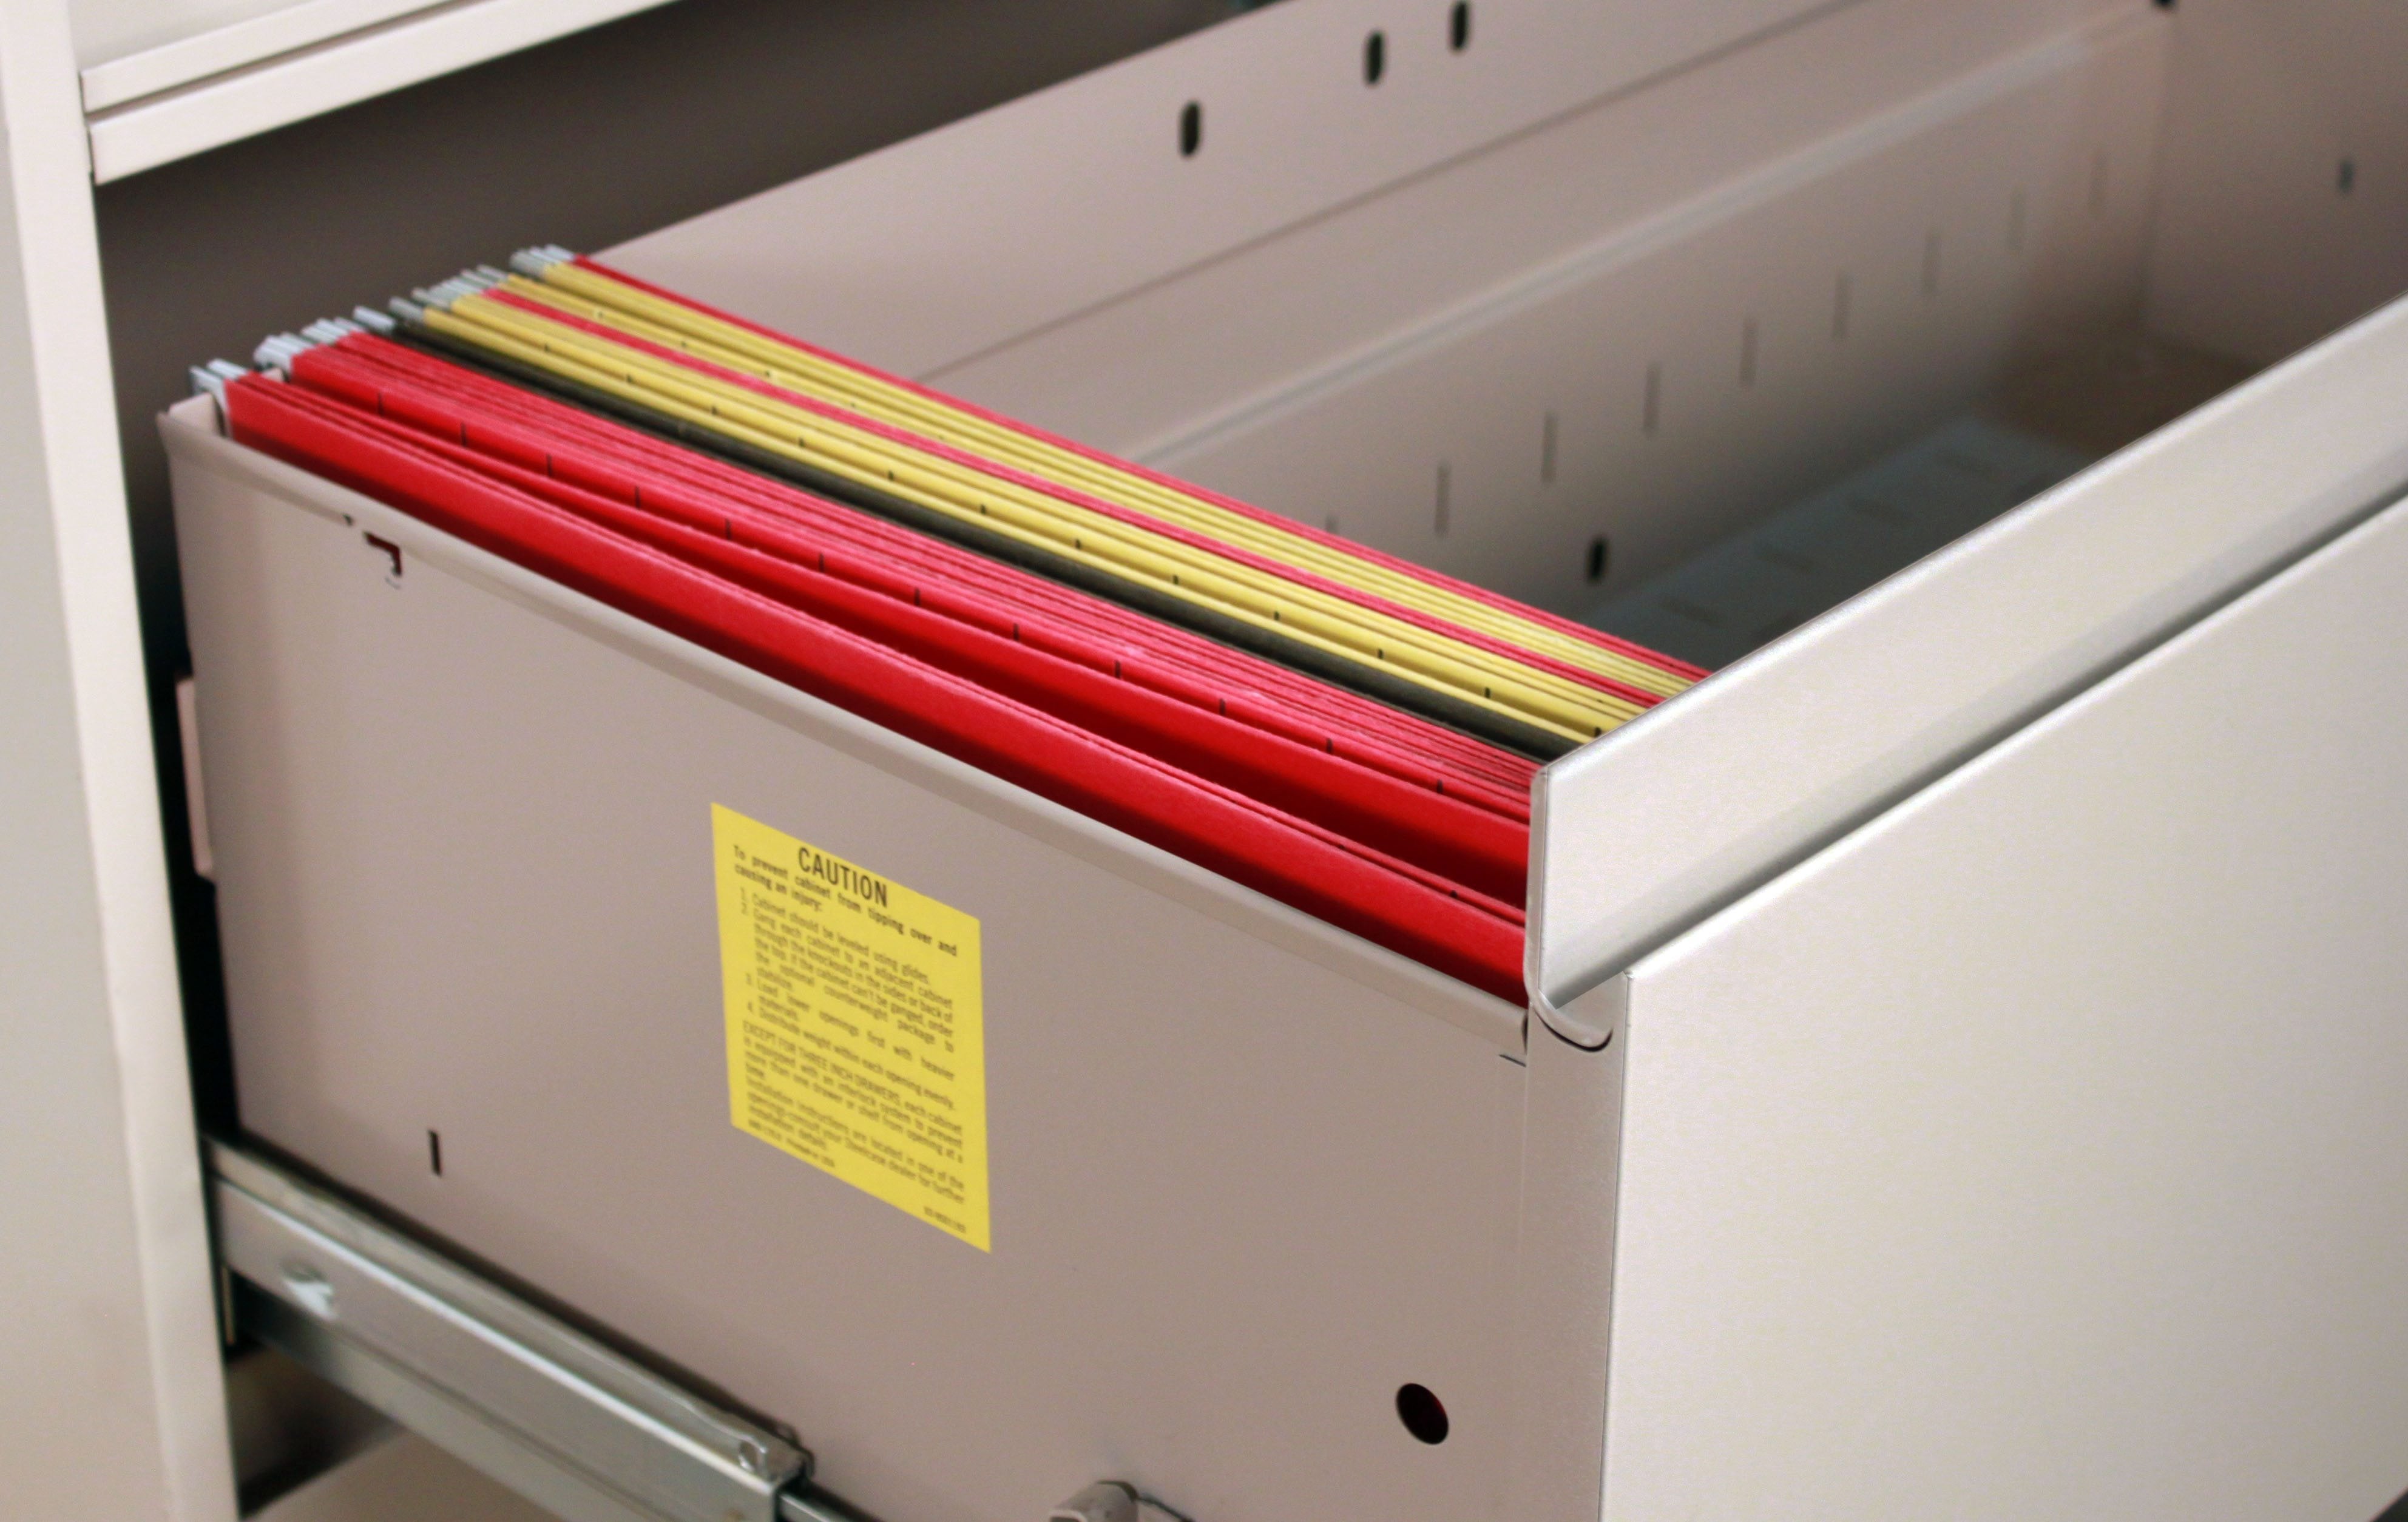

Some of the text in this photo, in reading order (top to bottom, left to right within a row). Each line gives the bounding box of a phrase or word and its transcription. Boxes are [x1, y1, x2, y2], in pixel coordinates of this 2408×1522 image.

[733, 844, 957, 956] To prevent cabinet from tipping over and
[734, 864, 772, 891] causing
[775, 882, 786, 894] an
[797, 847, 887, 907] CAUTION
[752, 893, 786, 917] Cabinet
[788, 912, 819, 933] should
[822, 926, 833, 940] be
[873, 952, 898, 972] using
[780, 923, 802, 938] each
[807, 935, 840, 956] cabinet
[844, 950, 854, 964] to
[874, 967, 914, 991] adjacent
[918, 986, 953, 1009] cabinet
[790, 940, 805, 953] the
[865, 975, 881, 990] the
[919, 999, 941, 1018] back
[943, 1012, 953, 1023] of
[928, 1020, 953, 1037] order
[944, 1040, 954, 1053] to
